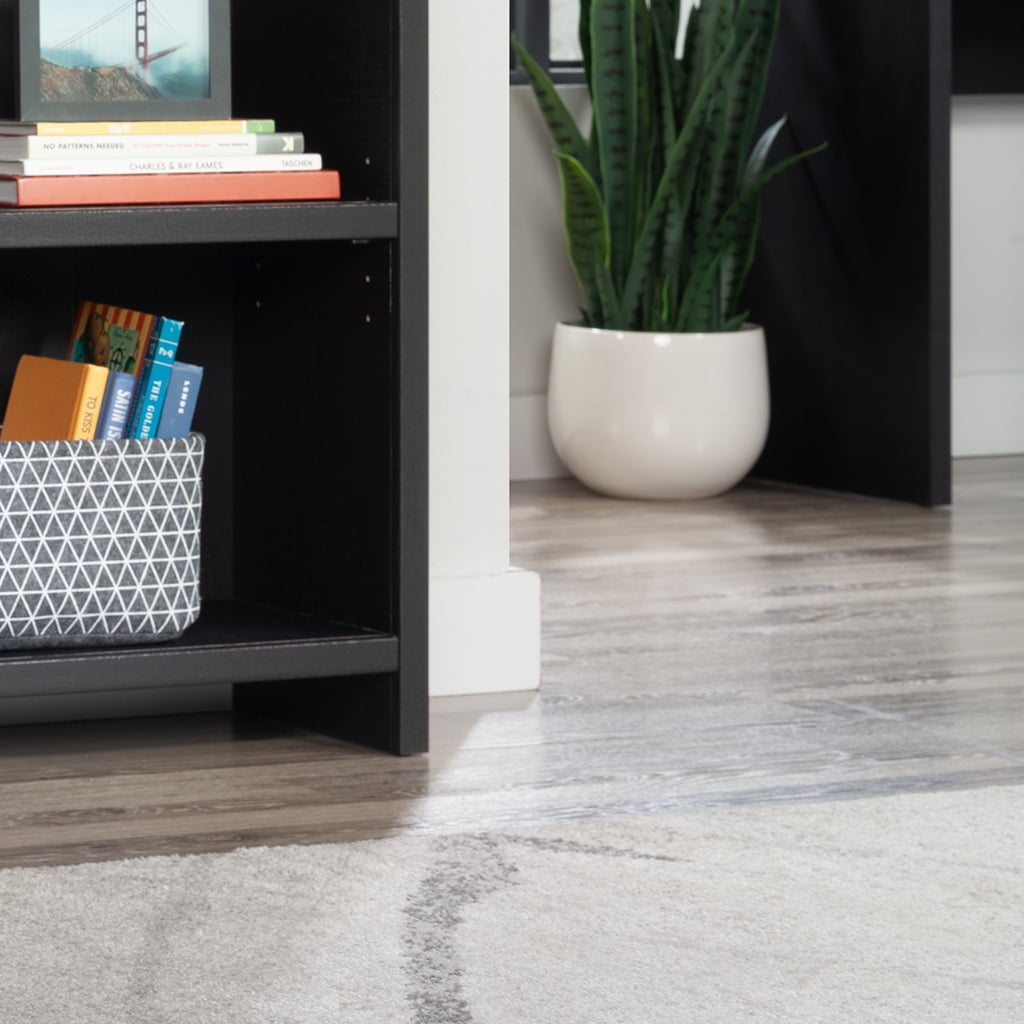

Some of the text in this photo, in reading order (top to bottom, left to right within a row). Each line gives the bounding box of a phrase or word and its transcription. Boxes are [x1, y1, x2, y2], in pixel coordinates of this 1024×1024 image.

[129, 161, 223, 171] CHARLES & RAY EAMES
[281, 159, 313, 168] TASCHEN
[149, 380, 161, 401] THE
[81, 396, 97, 434] TO KISS
